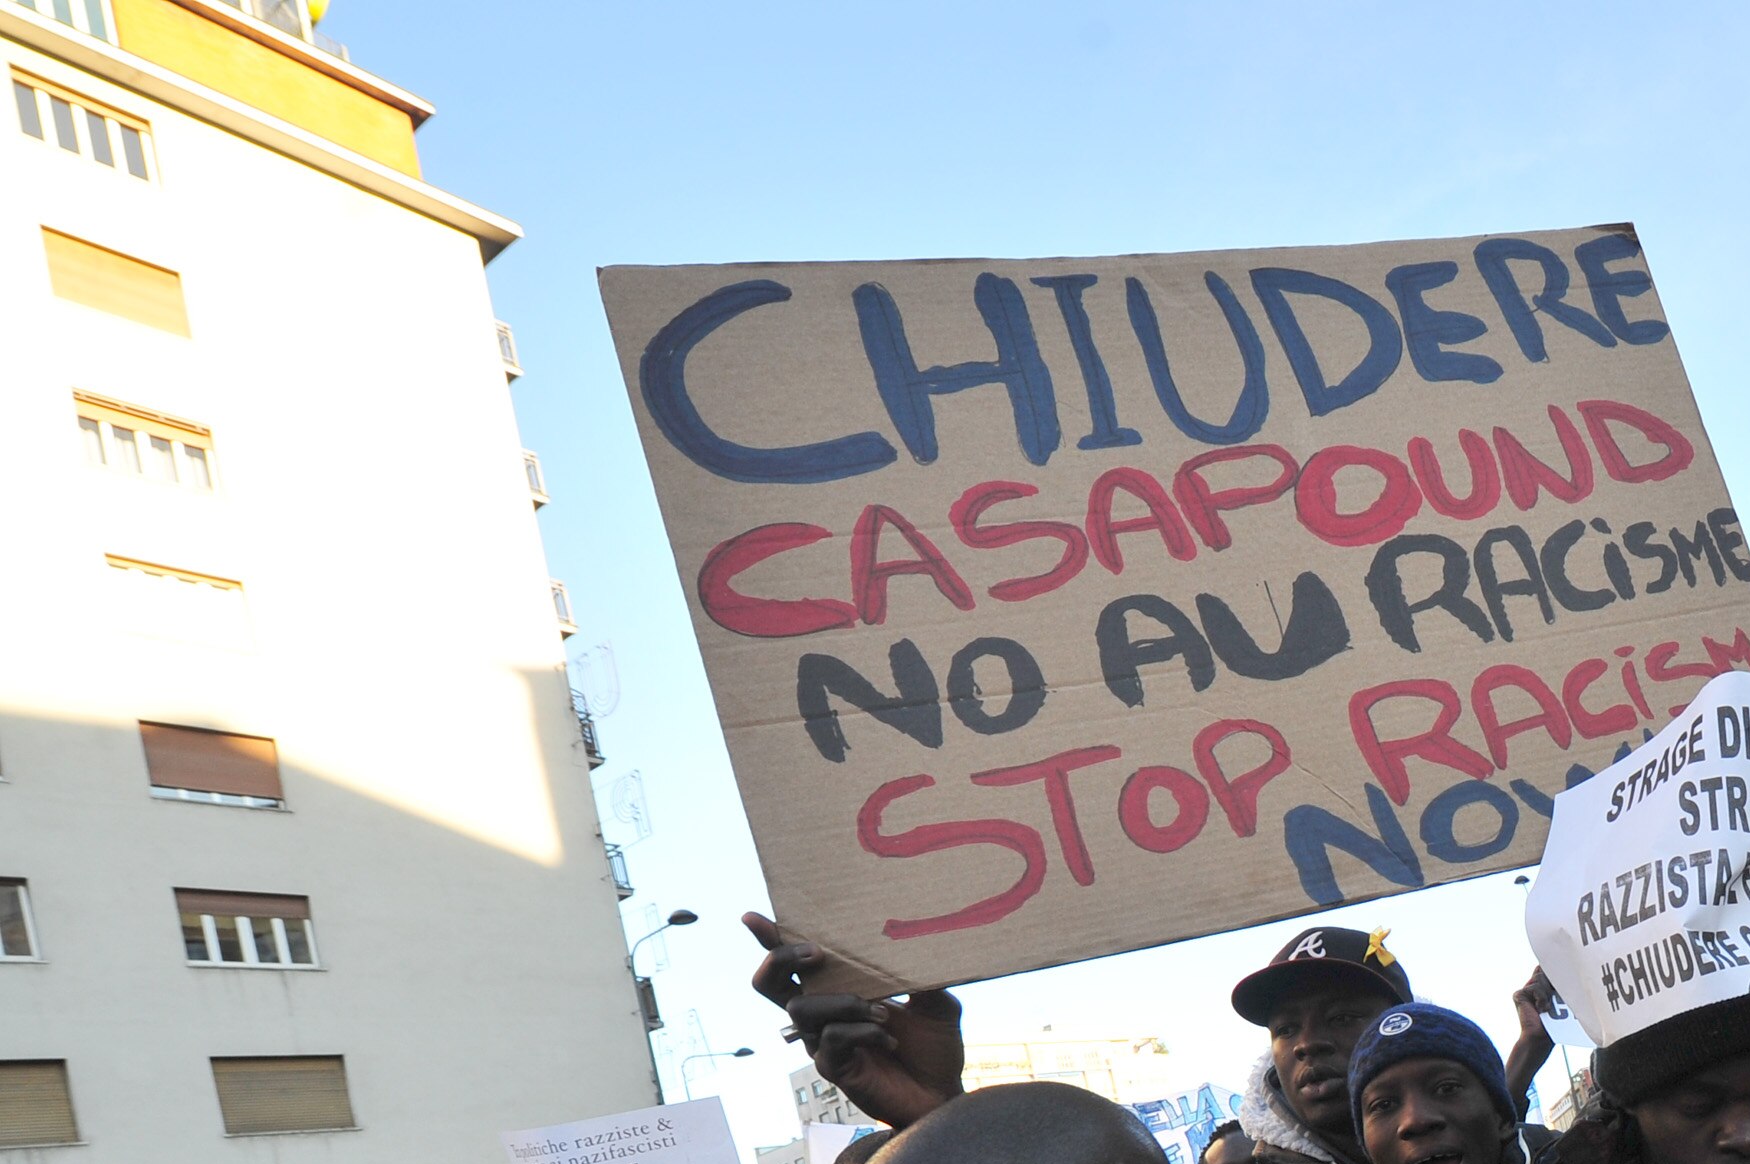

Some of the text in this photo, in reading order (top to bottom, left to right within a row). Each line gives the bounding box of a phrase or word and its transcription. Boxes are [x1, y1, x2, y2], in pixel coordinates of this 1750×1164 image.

[639, 233, 1670, 484] CHIUDERE
[697, 399, 1694, 637] CASAPOUND
[796, 636, 1048, 763] NO
[857, 718, 1291, 940] STOP
[1606, 713, 1706, 823] STRAGE
[1602, 930, 1750, 1013] #CHIUDERE
[575, 1123, 650, 1149] razziste
[657, 1117, 674, 1132] &
